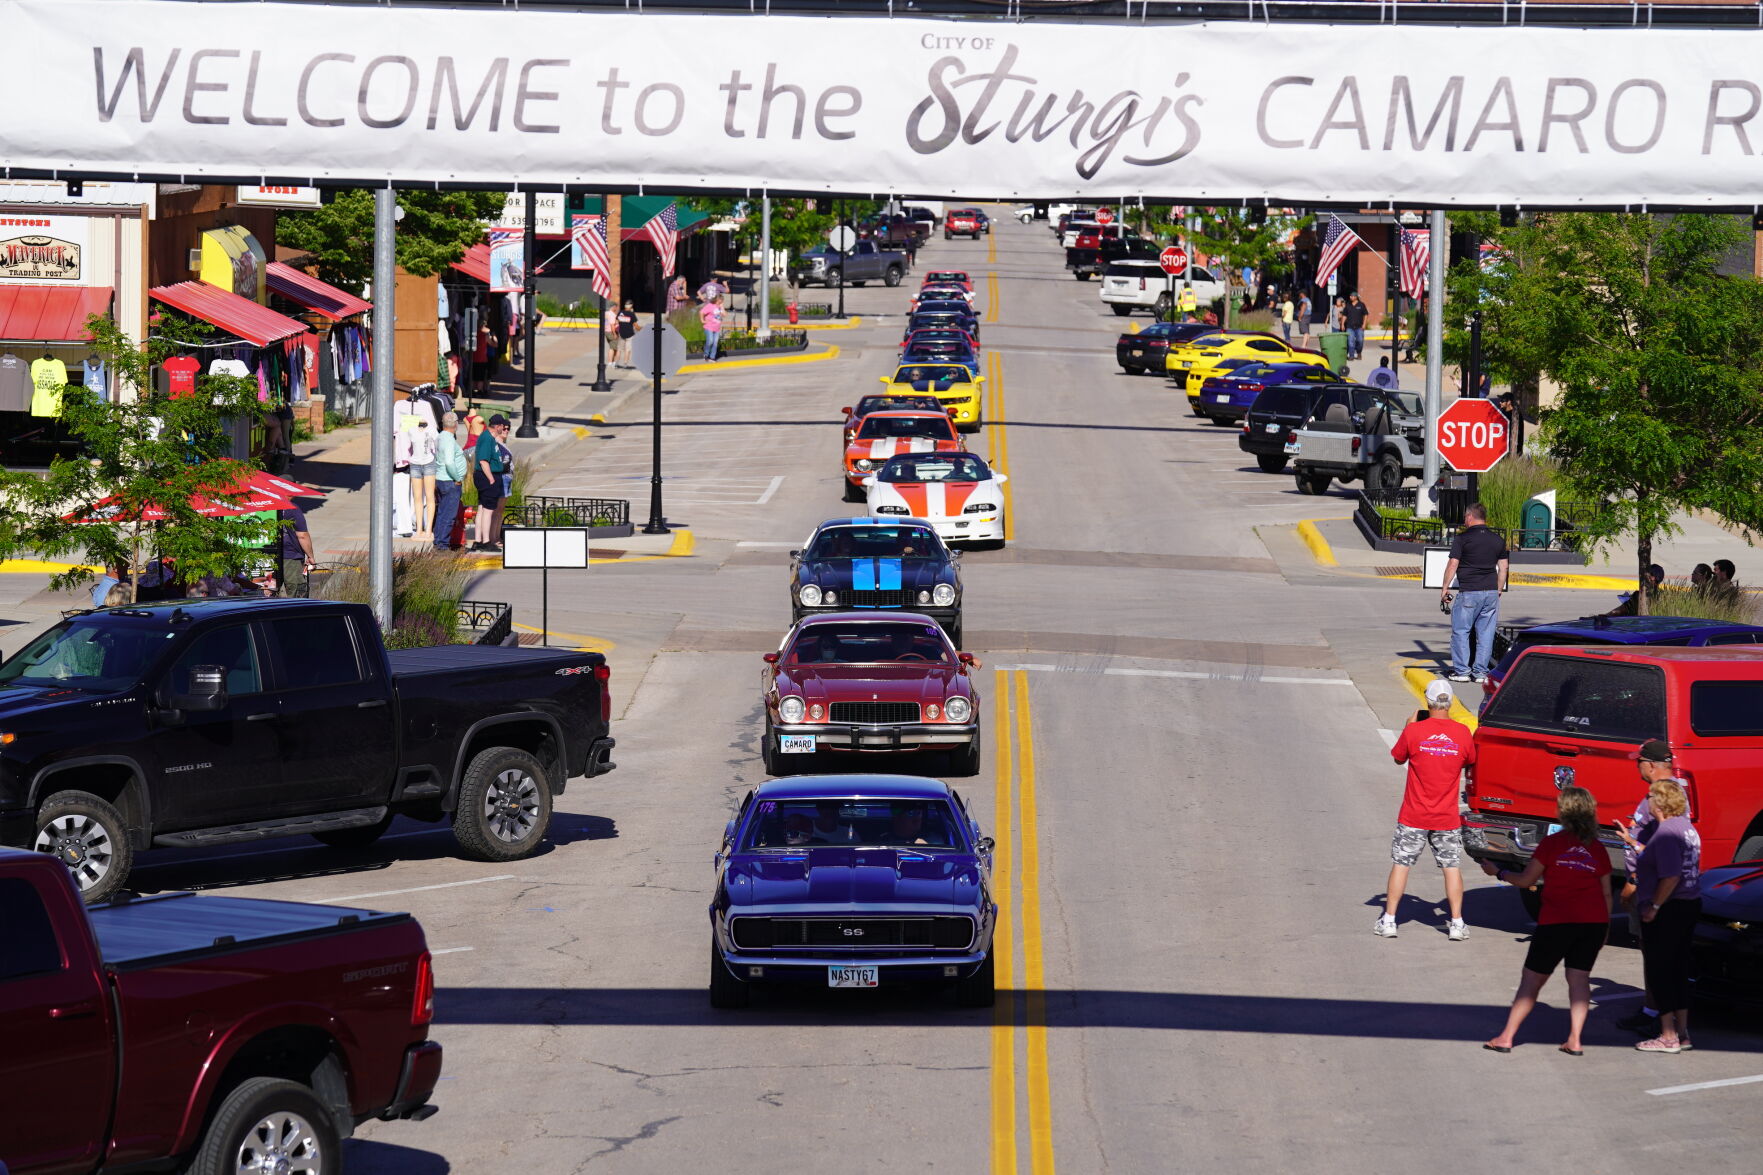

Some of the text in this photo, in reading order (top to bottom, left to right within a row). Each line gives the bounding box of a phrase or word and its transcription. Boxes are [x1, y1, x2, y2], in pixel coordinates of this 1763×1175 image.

[920, 33, 995, 51] CITY OF
[93, 43, 1763, 181] WELCOME to the Sturgis CAMARO R
[259, 185, 298, 195] STORE
[0, 218, 51, 227] EYSTONE
[5, 244, 69, 273] MAVERICK
[1162, 254, 1187, 267] STOP
[9, 269, 41, 277] TRADING
[1441, 421, 1504, 449] STOP
[784, 739, 812, 749] CAMARO
[165, 765, 194, 774] 2500
[759, 801, 776, 813] 175
[843, 928, 863, 936] SS
[831, 969, 875, 981] NASTY67
